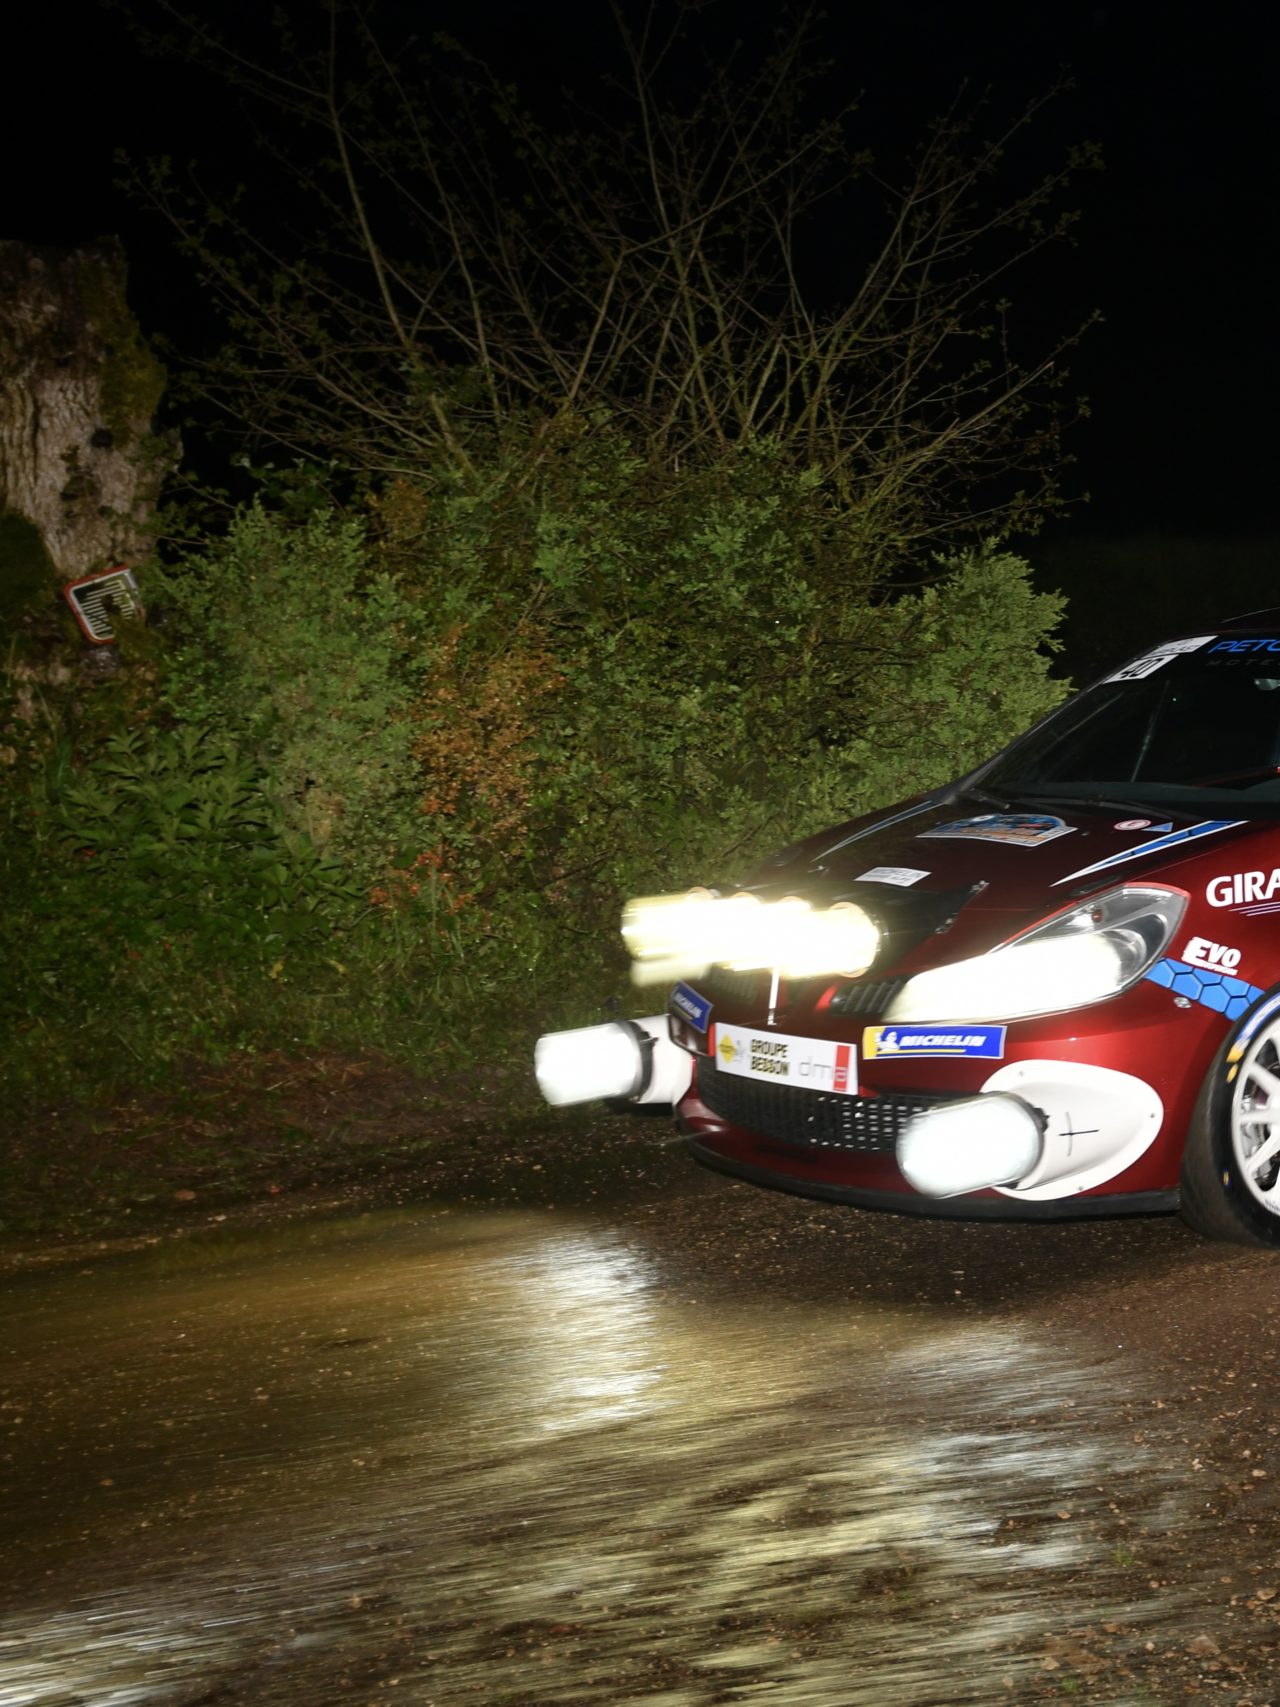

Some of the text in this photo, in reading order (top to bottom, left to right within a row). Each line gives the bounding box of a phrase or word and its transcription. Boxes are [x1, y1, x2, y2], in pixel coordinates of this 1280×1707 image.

[1182, 936, 1242, 969] EVO
[750, 1038, 789, 1058] GROUPE
[899, 1035, 987, 1047] MICHELIN
